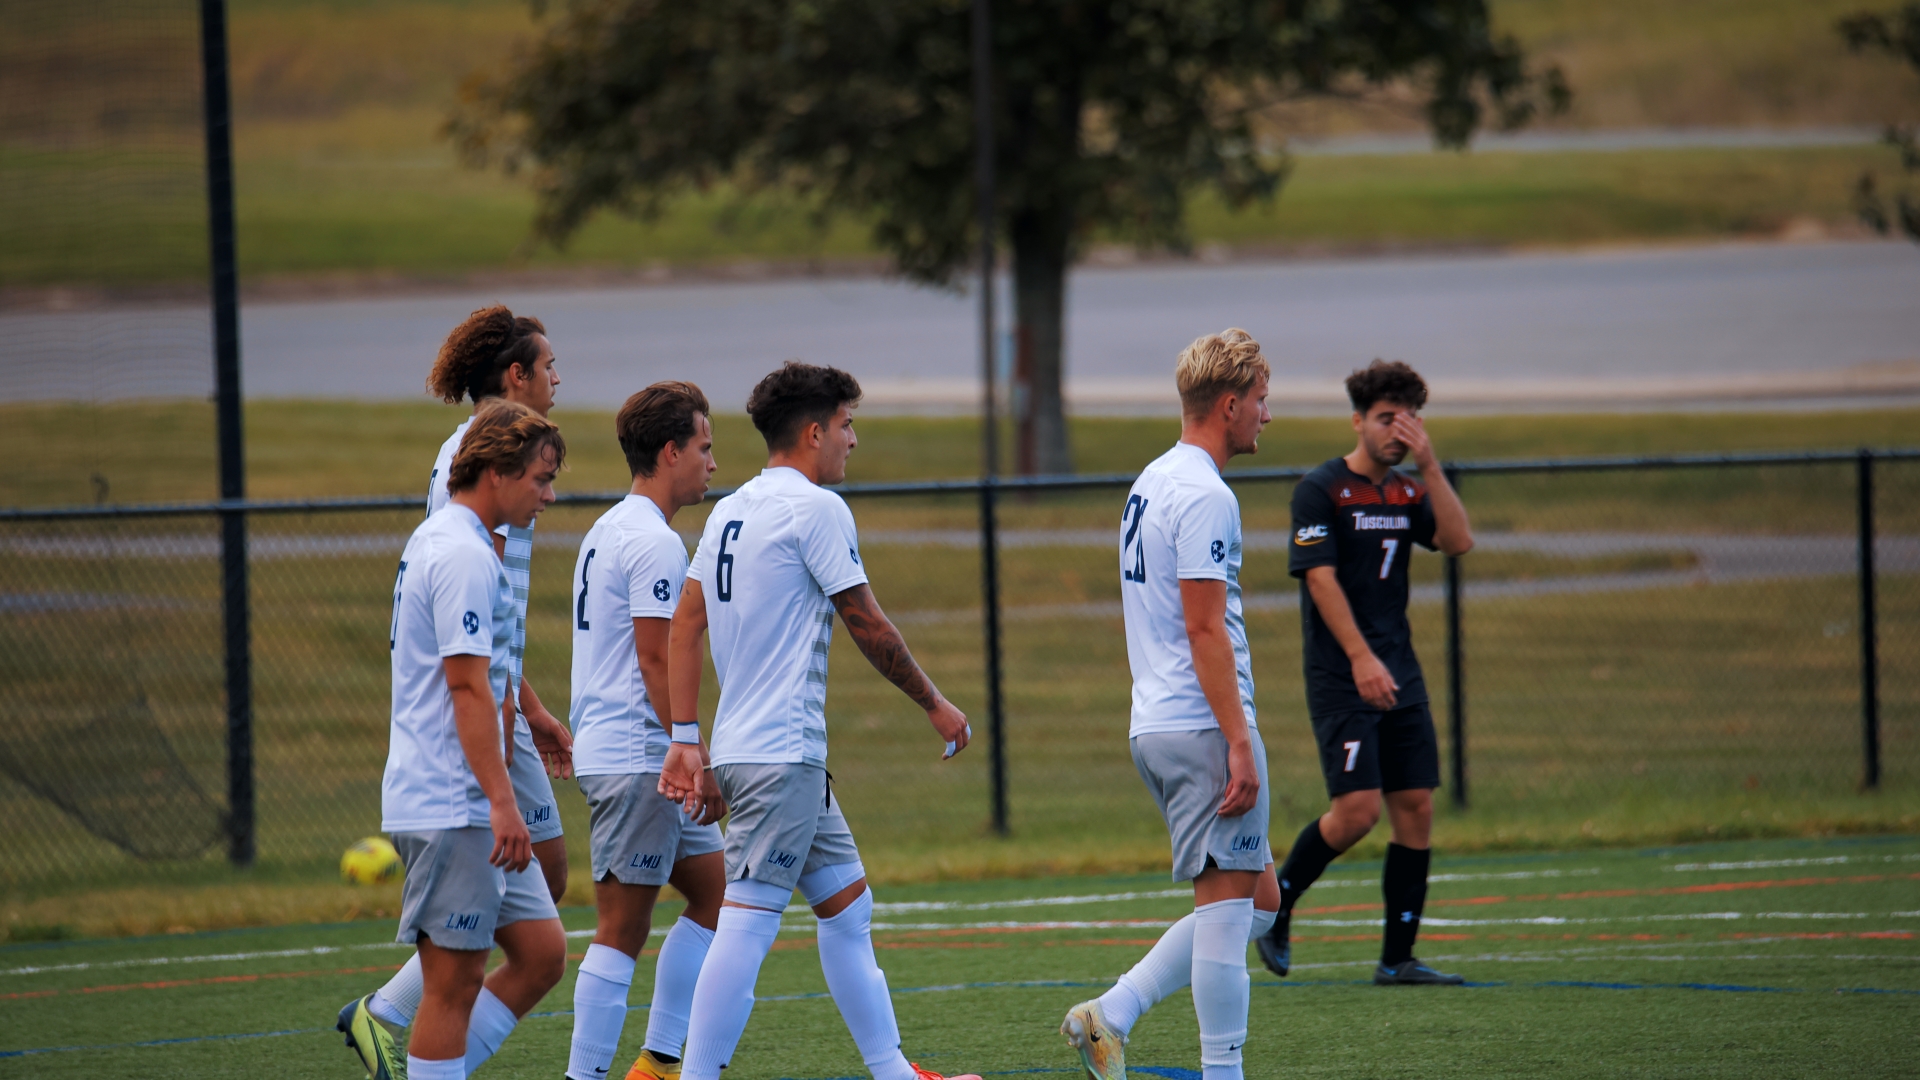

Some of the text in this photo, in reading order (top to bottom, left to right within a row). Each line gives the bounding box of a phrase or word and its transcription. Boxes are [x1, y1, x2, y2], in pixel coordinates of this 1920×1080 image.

[1297, 524, 1328, 541] SAC
[716, 520, 743, 602] 6
[1379, 539, 1398, 579] 7
[1344, 741, 1361, 772] 7
[526, 806, 550, 825] LMU
[1232, 836, 1261, 851] LMU
[630, 853, 662, 869] LMU
[767, 849, 797, 869] LMU
[445, 913, 481, 930] LMU
